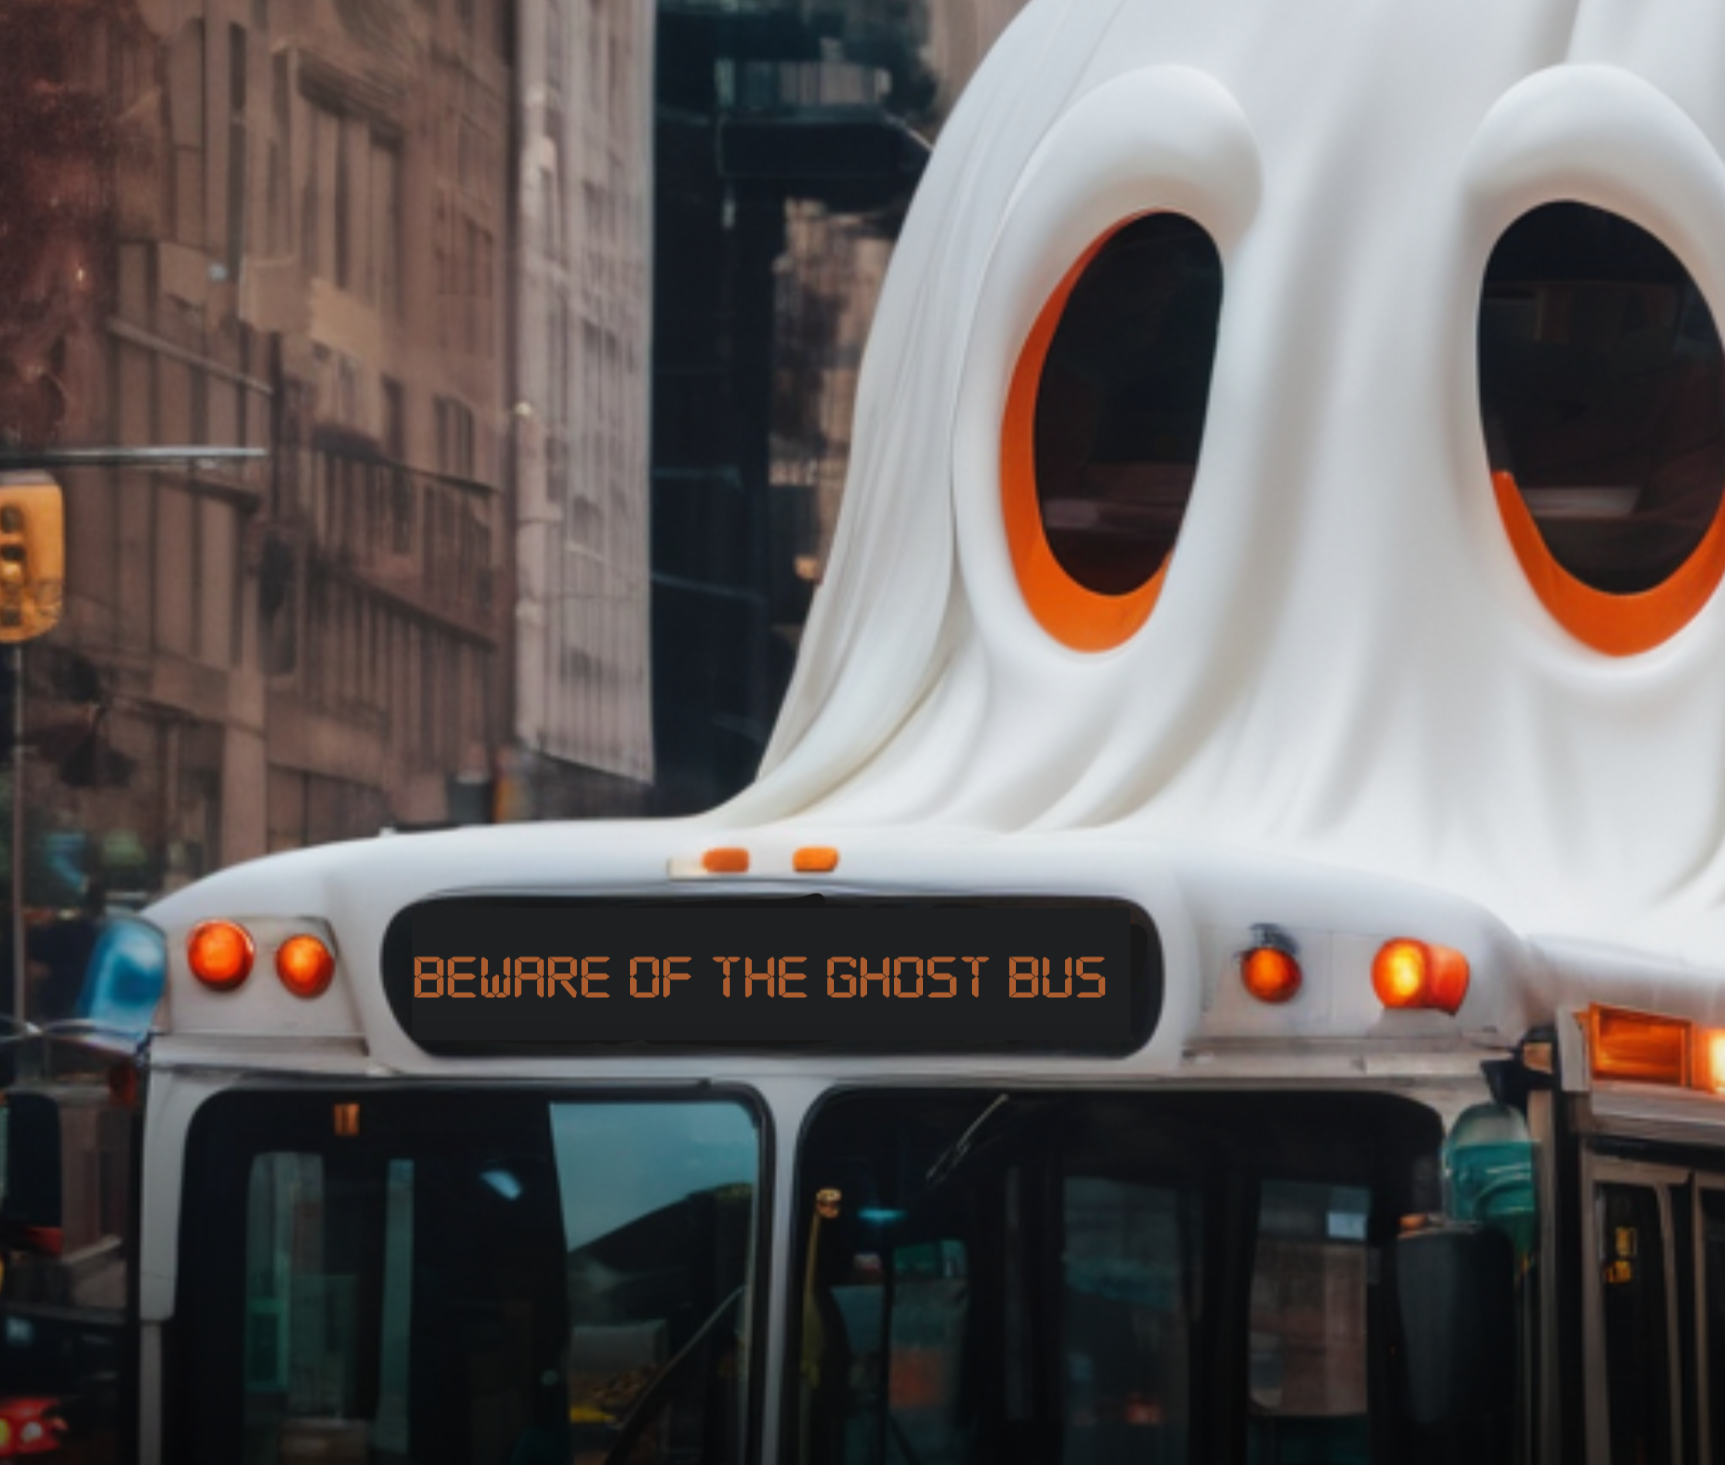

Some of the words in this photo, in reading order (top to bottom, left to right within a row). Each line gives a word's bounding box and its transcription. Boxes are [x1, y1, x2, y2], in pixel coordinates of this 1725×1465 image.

[414, 956, 610, 998] BEWARE
[630, 956, 692, 998] OF
[713, 956, 807, 998] THE
[827, 956, 989, 998] GHOST
[1009, 956, 1105, 998] BUS
